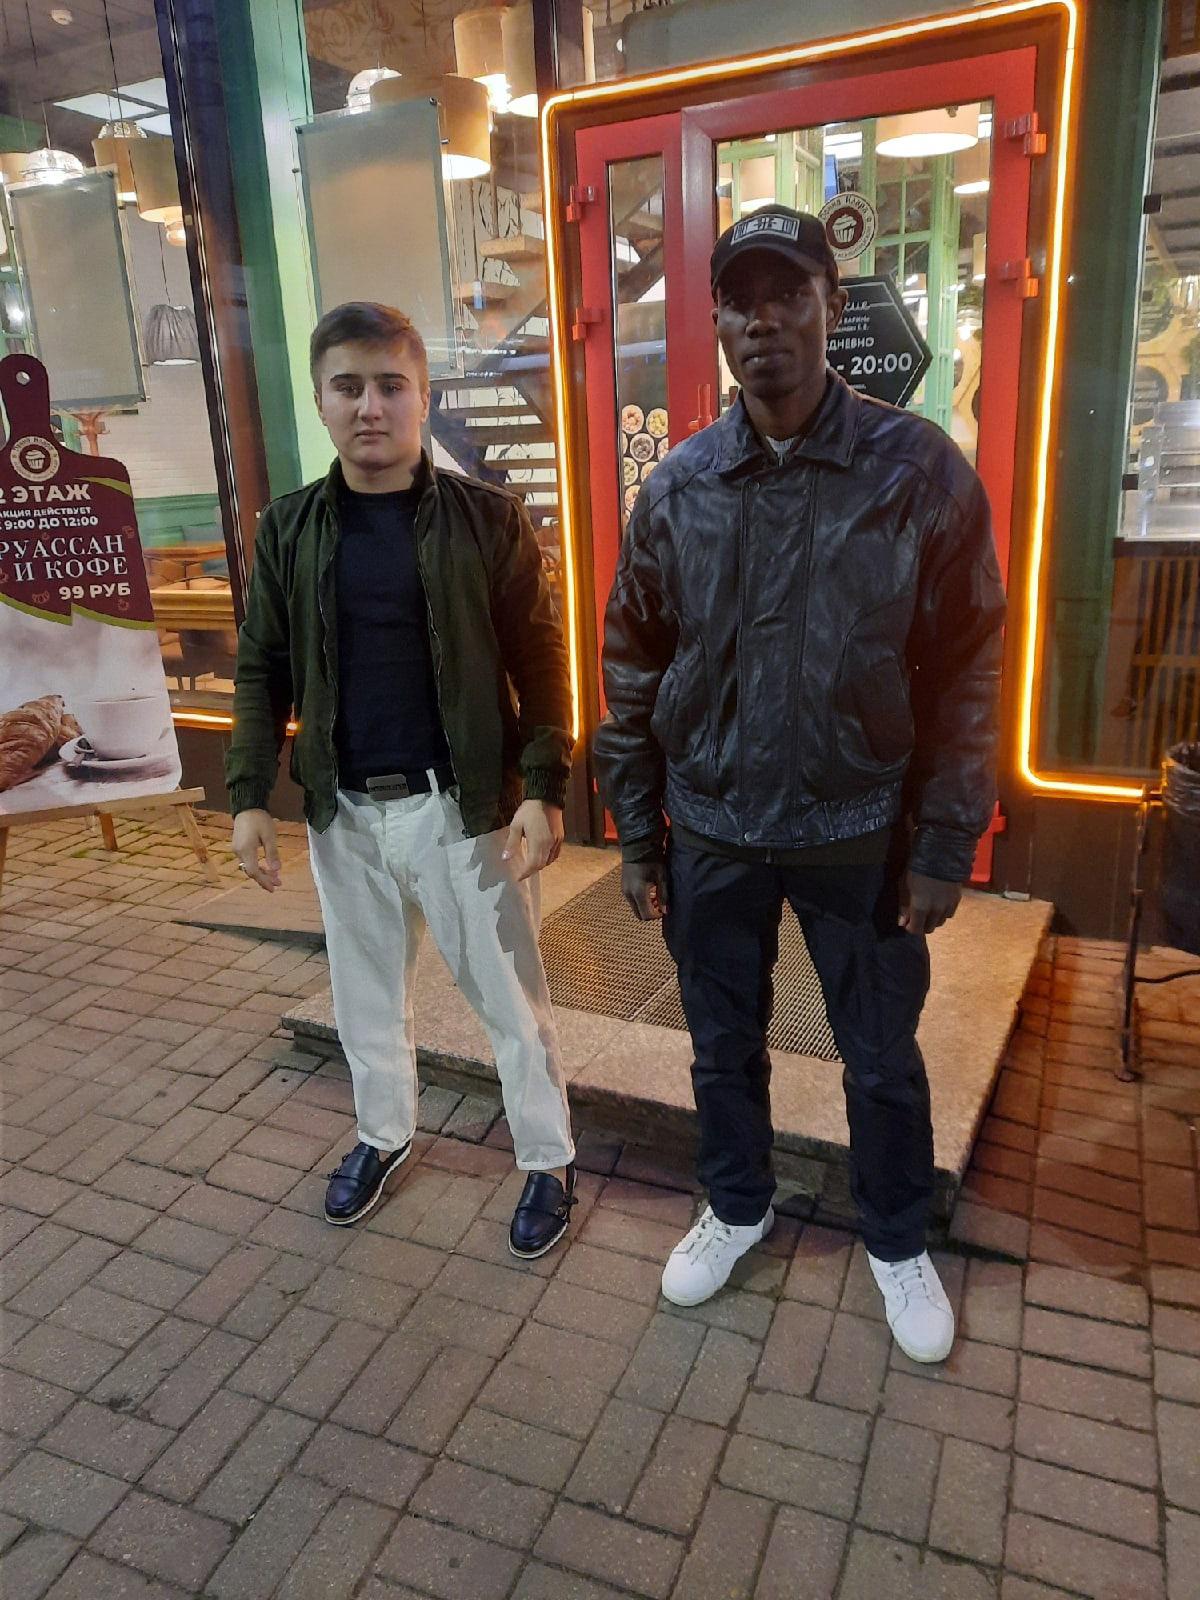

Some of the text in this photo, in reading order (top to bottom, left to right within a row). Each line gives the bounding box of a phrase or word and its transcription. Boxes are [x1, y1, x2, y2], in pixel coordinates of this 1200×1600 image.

[850, 352, 913, 375] 20:00
[11, 483, 92, 504] ЭТАЖ
[33, 506, 92, 518] ДЕЙСТВУЕТ
[4, 519, 35, 531] 9:00
[38, 517, 60, 530] ДО
[62, 516, 99, 527] 12:00
[13, 556, 128, 582] И КОФЕ
[58, 582, 131, 601] 99 РУБ
